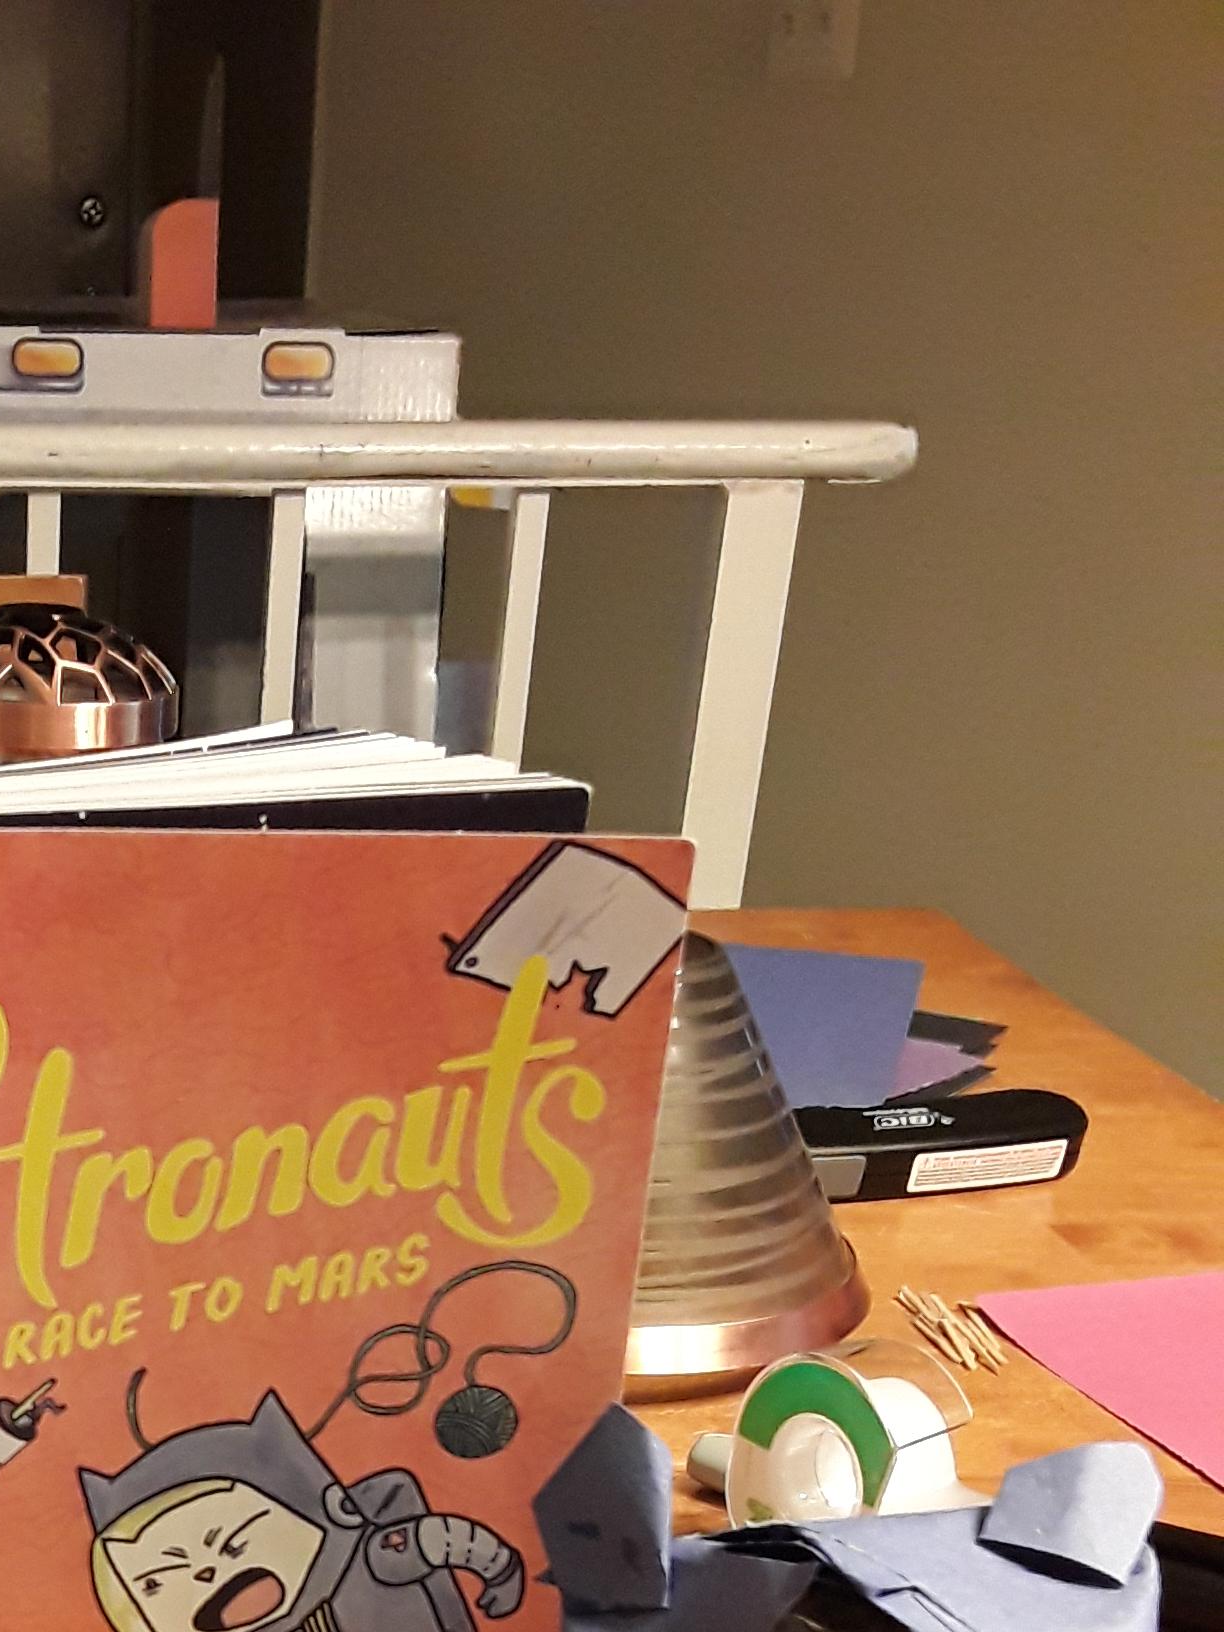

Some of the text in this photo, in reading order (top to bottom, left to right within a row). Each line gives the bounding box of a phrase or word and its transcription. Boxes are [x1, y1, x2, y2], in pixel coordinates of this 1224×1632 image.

[2, 1232, 432, 1370] RACE TO MARS
